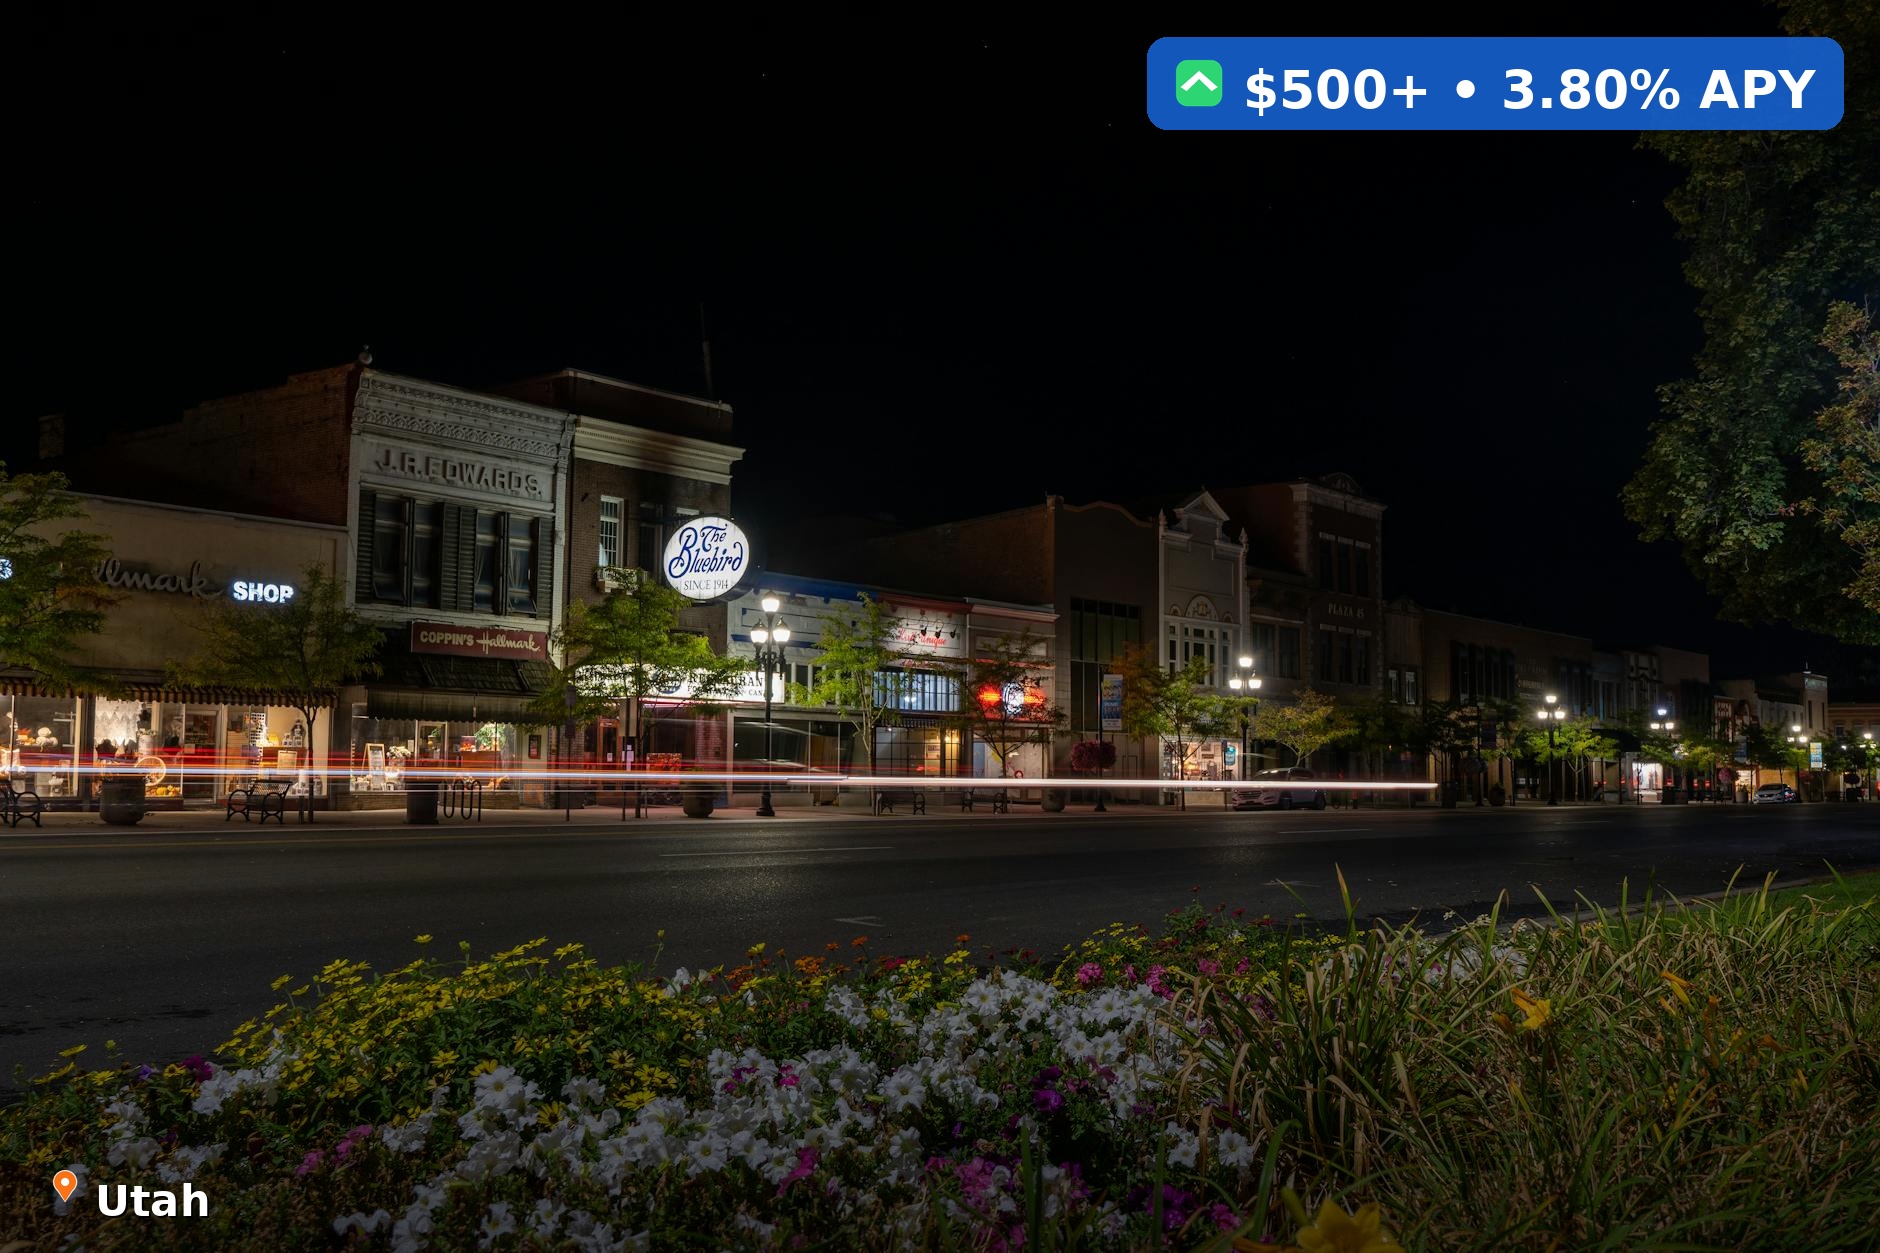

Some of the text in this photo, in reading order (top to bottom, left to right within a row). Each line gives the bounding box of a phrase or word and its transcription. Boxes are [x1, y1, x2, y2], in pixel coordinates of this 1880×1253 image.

[700, 523, 728, 553] The
[668, 526, 743, 579] Bluebird
[233, 581, 294, 604] SHOP
[683, 579, 729, 591] SINCE 1914
[420, 630, 541, 655] COPPIN'S Hallmark
